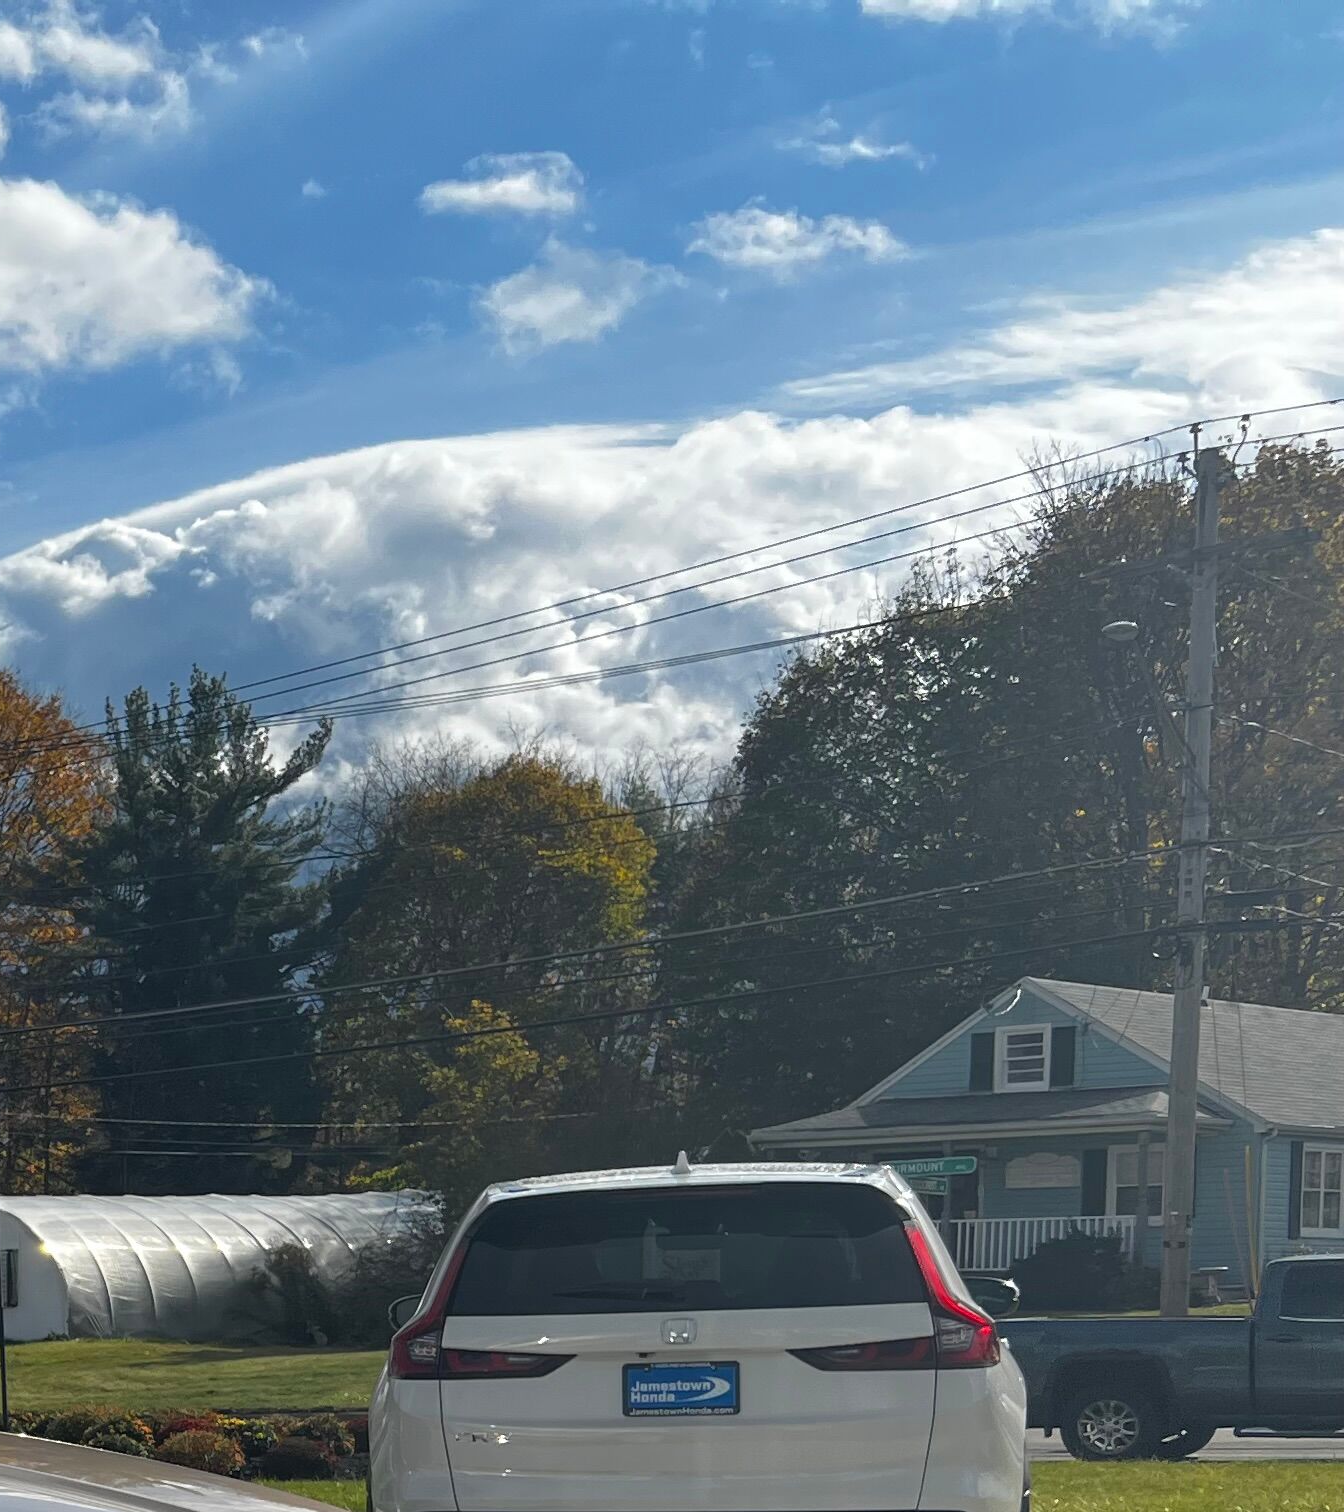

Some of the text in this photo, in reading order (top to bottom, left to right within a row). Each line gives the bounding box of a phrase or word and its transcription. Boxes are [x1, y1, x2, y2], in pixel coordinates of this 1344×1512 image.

[630, 1380, 712, 1392] Jamestown
[630, 1391, 676, 1403] Honda
[629, 1406, 734, 1416] JamestownHonda.com
